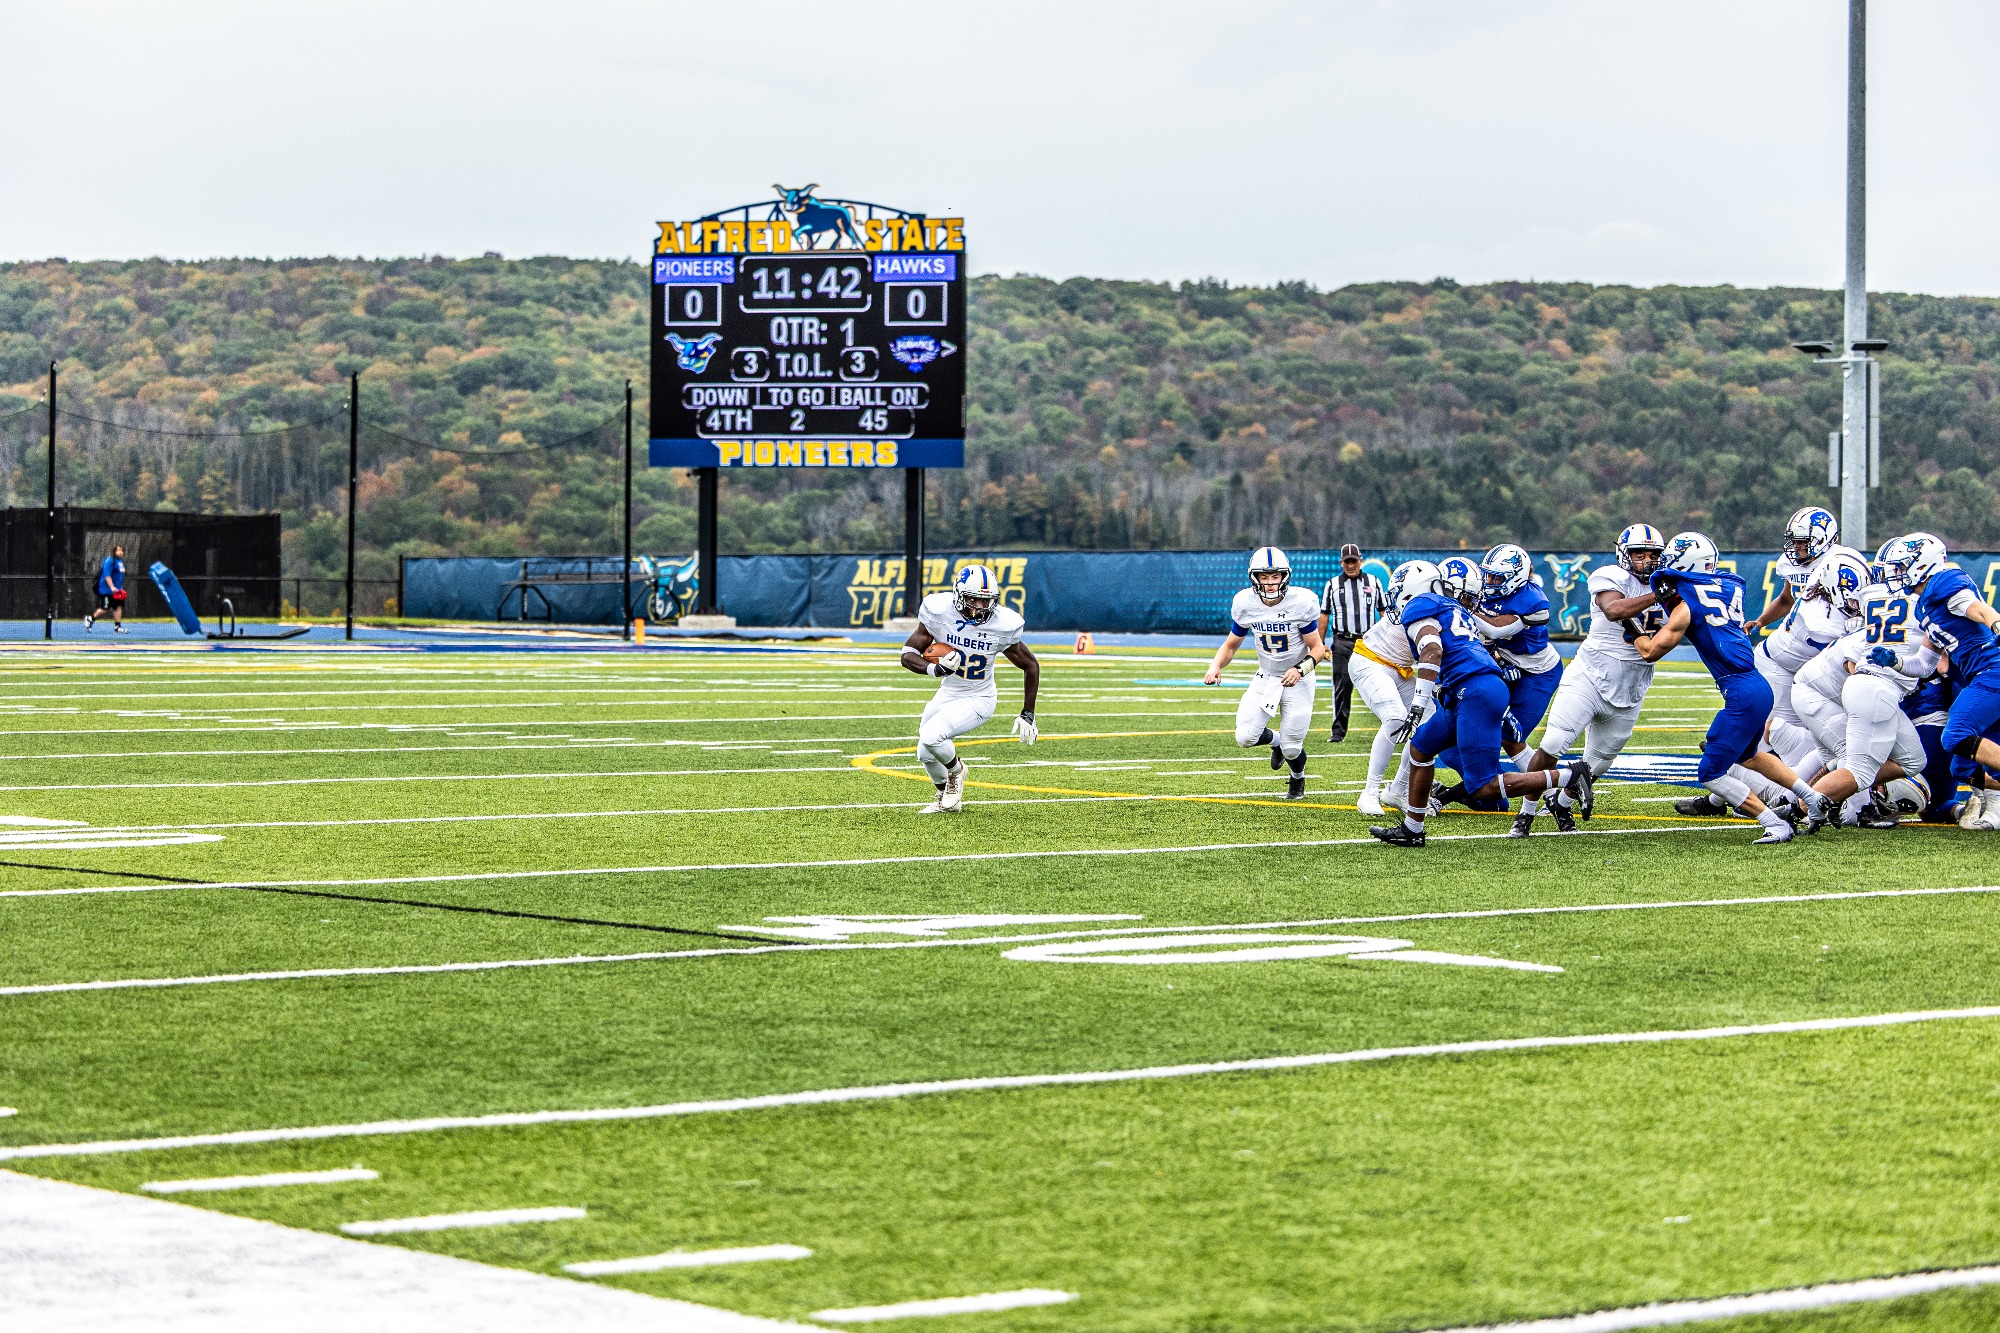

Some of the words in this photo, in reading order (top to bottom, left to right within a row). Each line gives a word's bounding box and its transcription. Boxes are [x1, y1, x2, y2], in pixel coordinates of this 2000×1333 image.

[656, 221, 791, 253] ALFRED
[865, 218, 964, 252] STATE
[656, 256, 734, 277] PIONEERS
[876, 258, 945, 274] HAWKS
[752, 267, 862, 300] 11:42
[684, 289, 703, 319] 0
[907, 288, 926, 318] 0
[770, 316, 828, 346] QTR:
[840, 318, 855, 346] 1
[743, 352, 759, 374] 3
[775, 353, 832, 378] T.O.L.
[851, 351, 867, 373] 3
[691, 388, 748, 406] DOWN
[768, 388, 793, 406] TO
[797, 388, 824, 406] GO
[840, 388, 886, 406] BALL
[891, 388, 919, 406] ON
[705, 409, 753, 431] 4TH
[789, 409, 806, 431] 2
[858, 409, 888, 431] 45
[711, 440, 898, 467] PIONEERS
[1694, 584, 1745, 628] 54
[1251, 622, 1292, 633] HILBERT
[1866, 597, 1909, 645] 52
[946, 633, 992, 651] HILBERT
[1077, 635, 1087, 651] G
